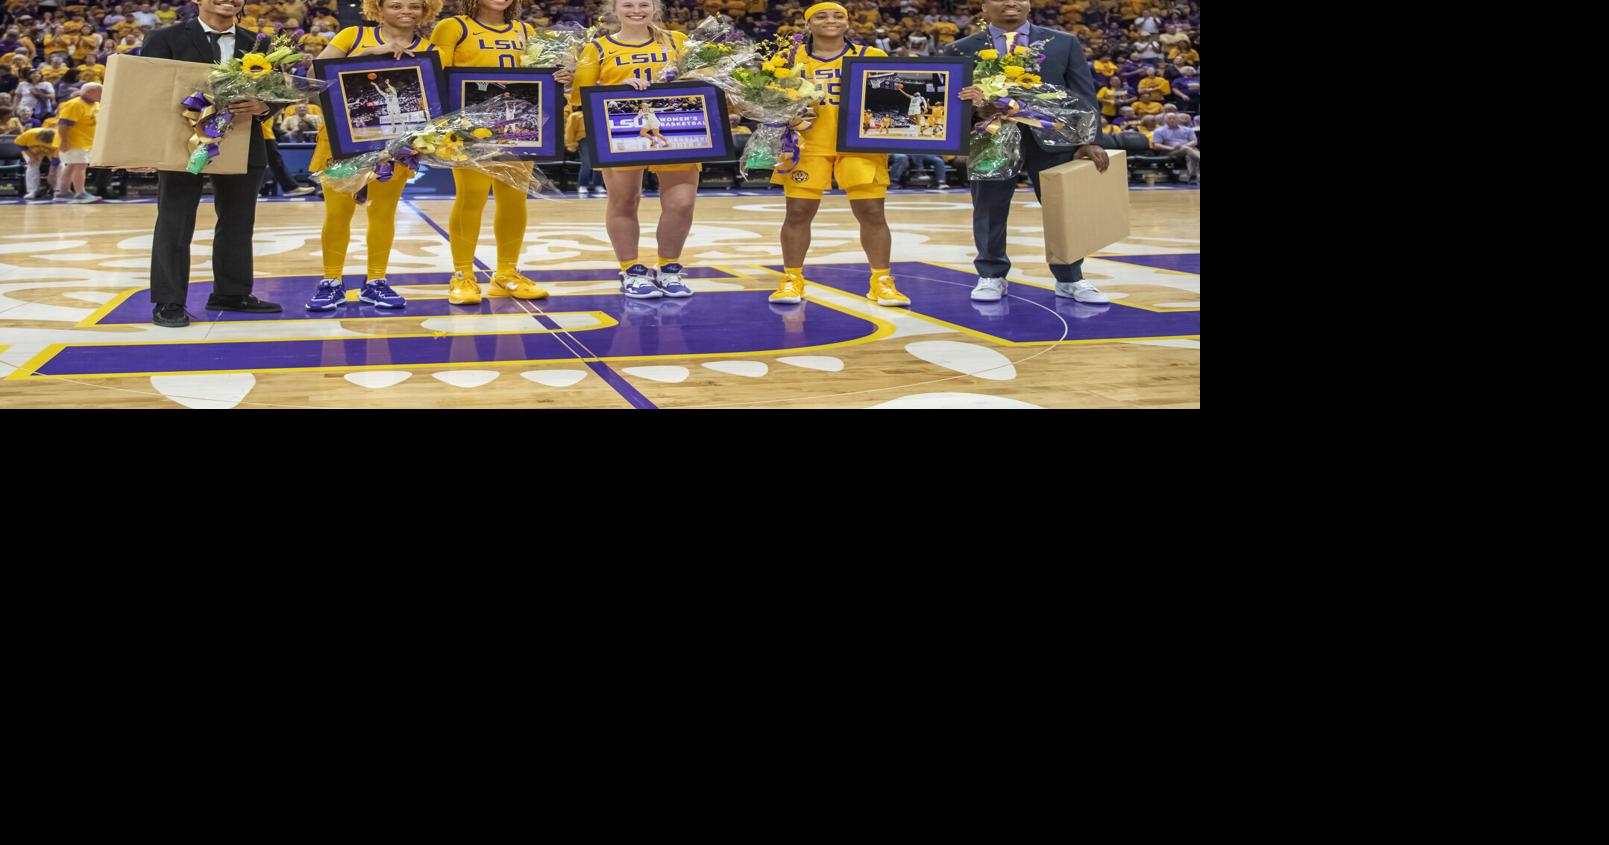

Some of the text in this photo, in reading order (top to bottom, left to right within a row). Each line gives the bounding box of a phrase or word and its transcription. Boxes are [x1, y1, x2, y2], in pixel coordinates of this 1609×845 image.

[478, 39, 523, 50] LSU
[616, 53, 667, 66] LSU
[633, 68, 652, 81] 11
[609, 118, 646, 128] LSU
